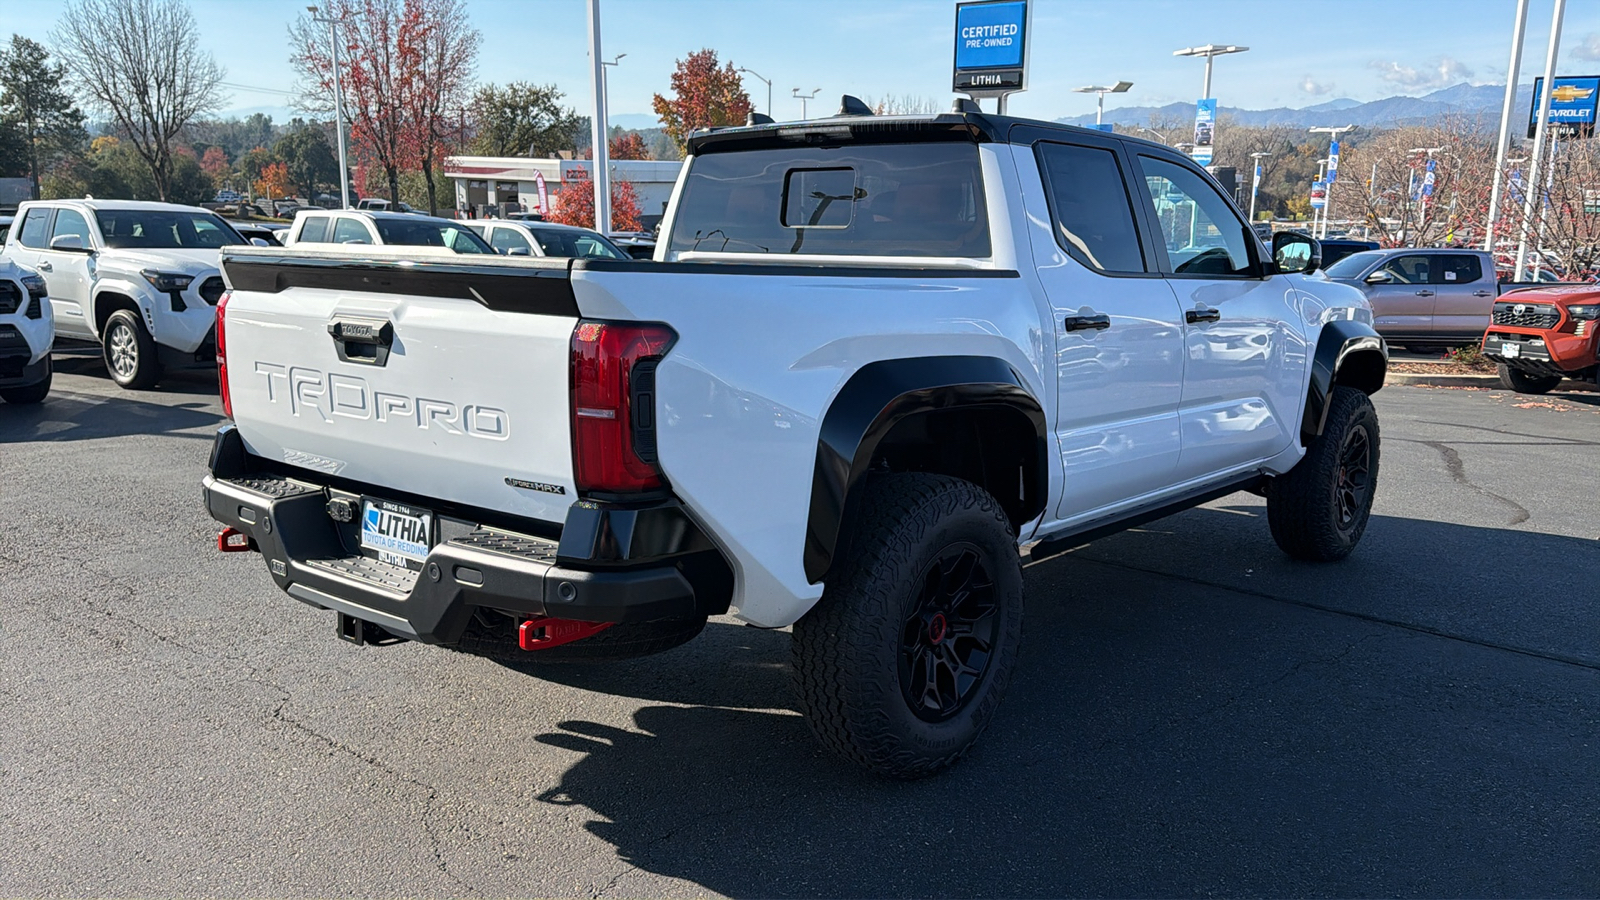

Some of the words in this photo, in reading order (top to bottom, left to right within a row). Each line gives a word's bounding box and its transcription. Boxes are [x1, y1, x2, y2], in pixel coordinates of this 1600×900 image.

[962, 24, 1018, 38] CERTIFIED
[966, 37, 1012, 48] PRE-OWNED
[971, 75, 1001, 85] LITHIA
[1536, 109, 1591, 117] CEVROLET
[342, 324, 371, 336] TOYOTA
[255, 361, 373, 424] TRD
[374, 391, 511, 441] PRO
[535, 482, 561, 493] MAX
[383, 502, 398, 512] SINCE
[399, 506, 410, 514] 1946
[378, 512, 428, 546] LITHIA
[364, 532, 386, 545] TOYOTA
[388, 539, 395, 548] OF
[397, 541, 428, 556] REDDING
